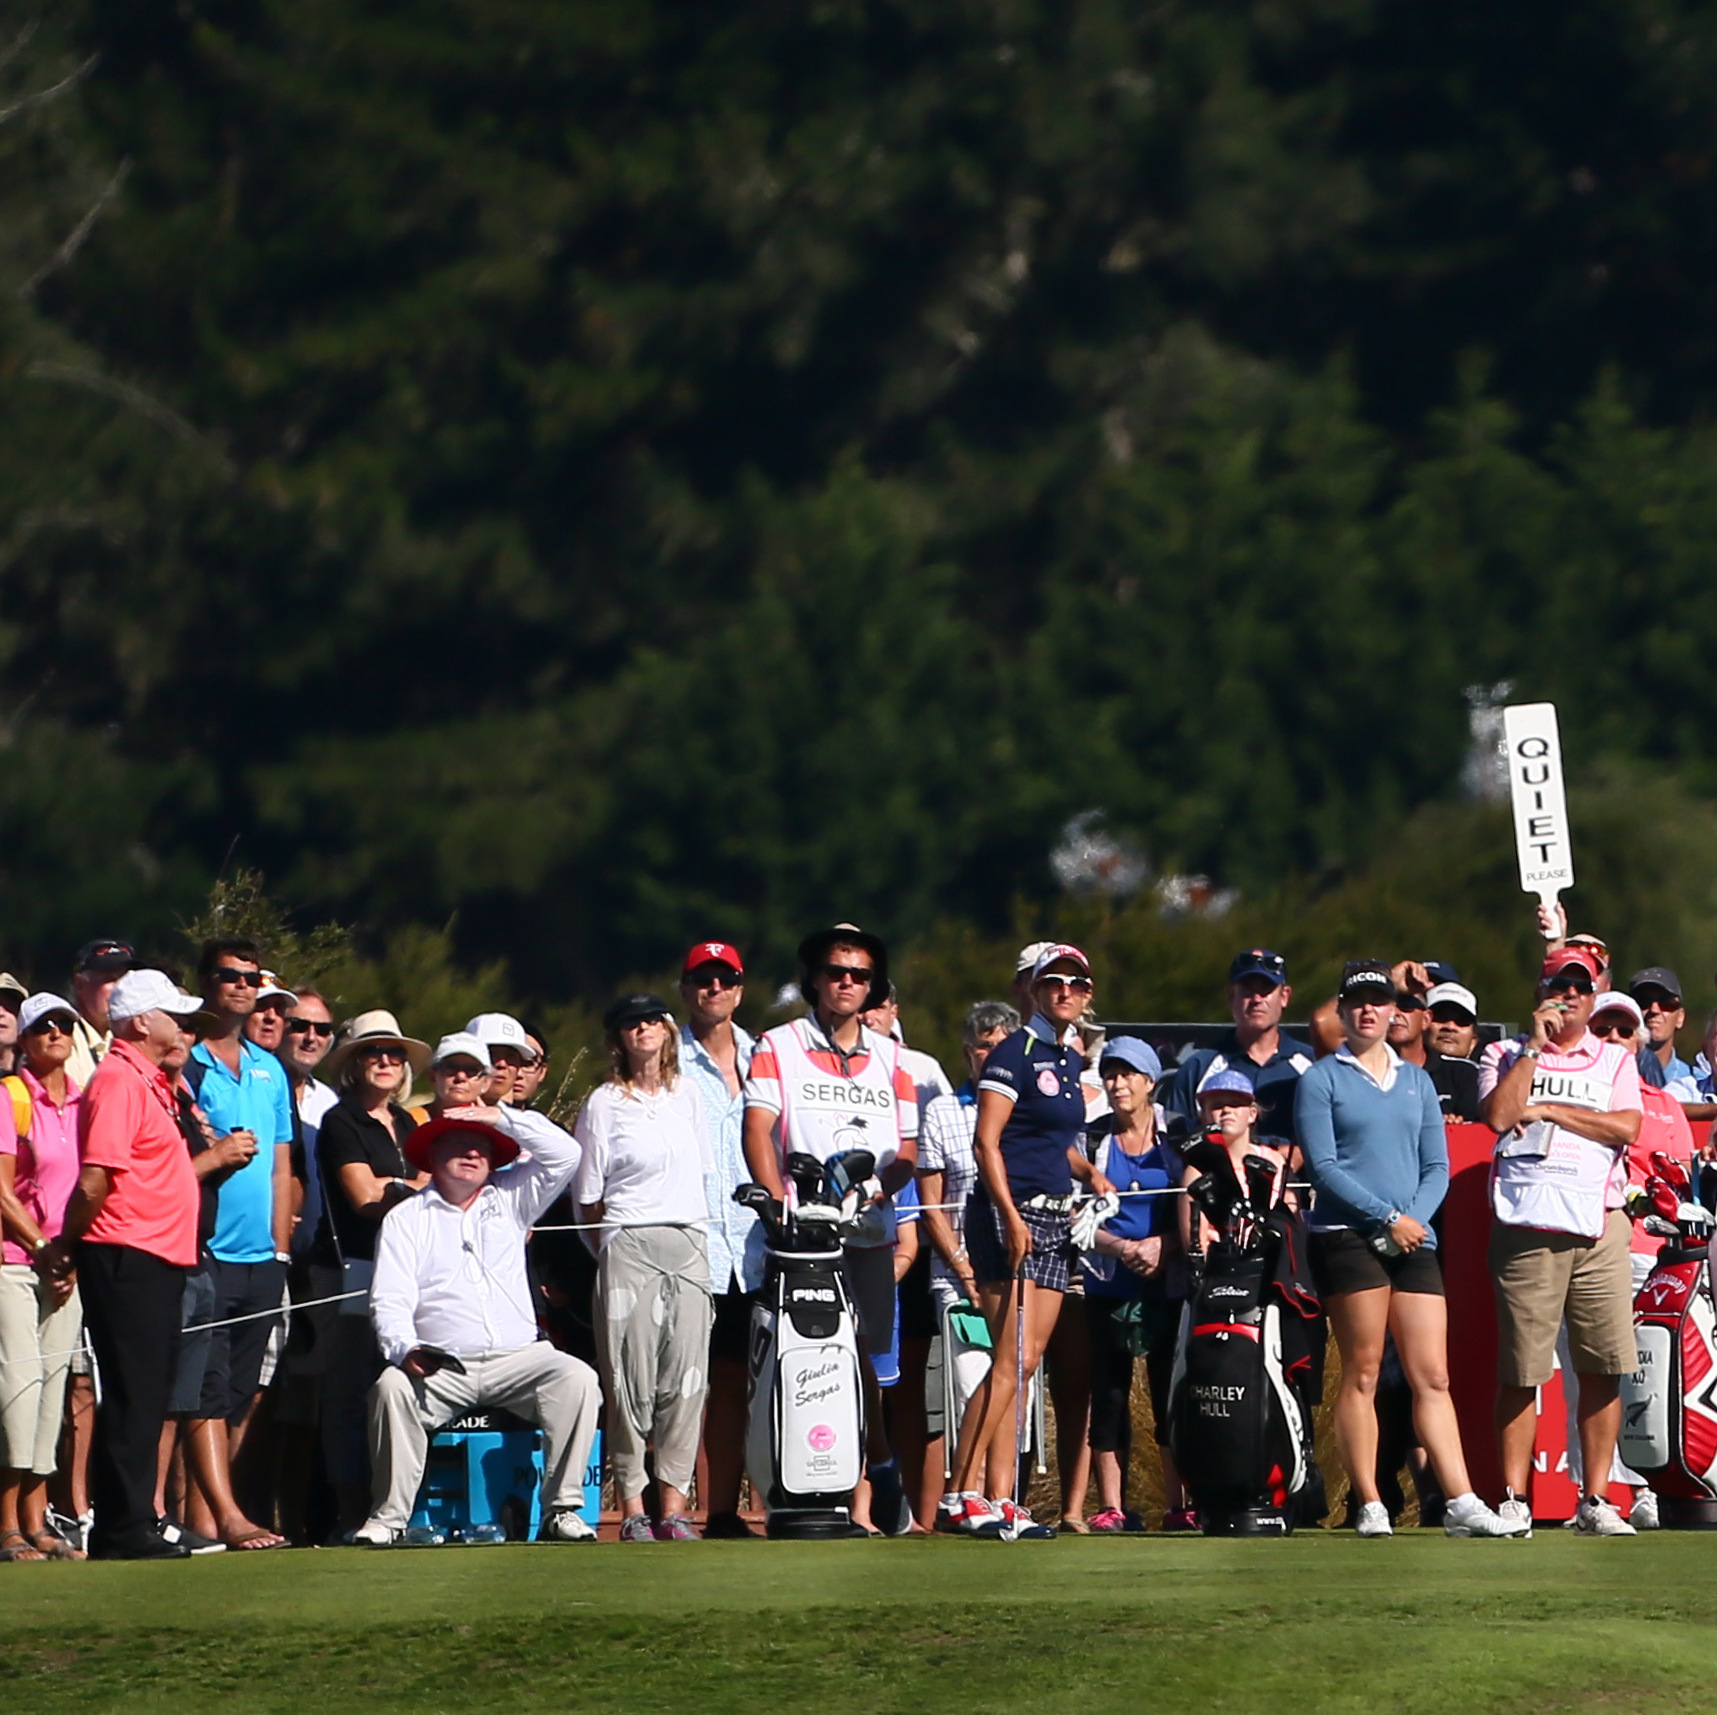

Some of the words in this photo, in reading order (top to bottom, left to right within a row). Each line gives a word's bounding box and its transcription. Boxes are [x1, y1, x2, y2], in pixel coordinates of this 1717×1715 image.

[1517, 737, 1558, 864] QUIET
[1526, 868, 1568, 882] PLEASE
[803, 1083, 890, 1108] SERGAS
[1530, 1077, 1598, 1103] HULL
[792, 1289, 836, 1302] PING
[795, 1362, 841, 1389] Giulia
[795, 1382, 841, 1407] Sergas
[1192, 1386, 1246, 1401] CHARLEY
[1201, 1403, 1231, 1418] HULL
